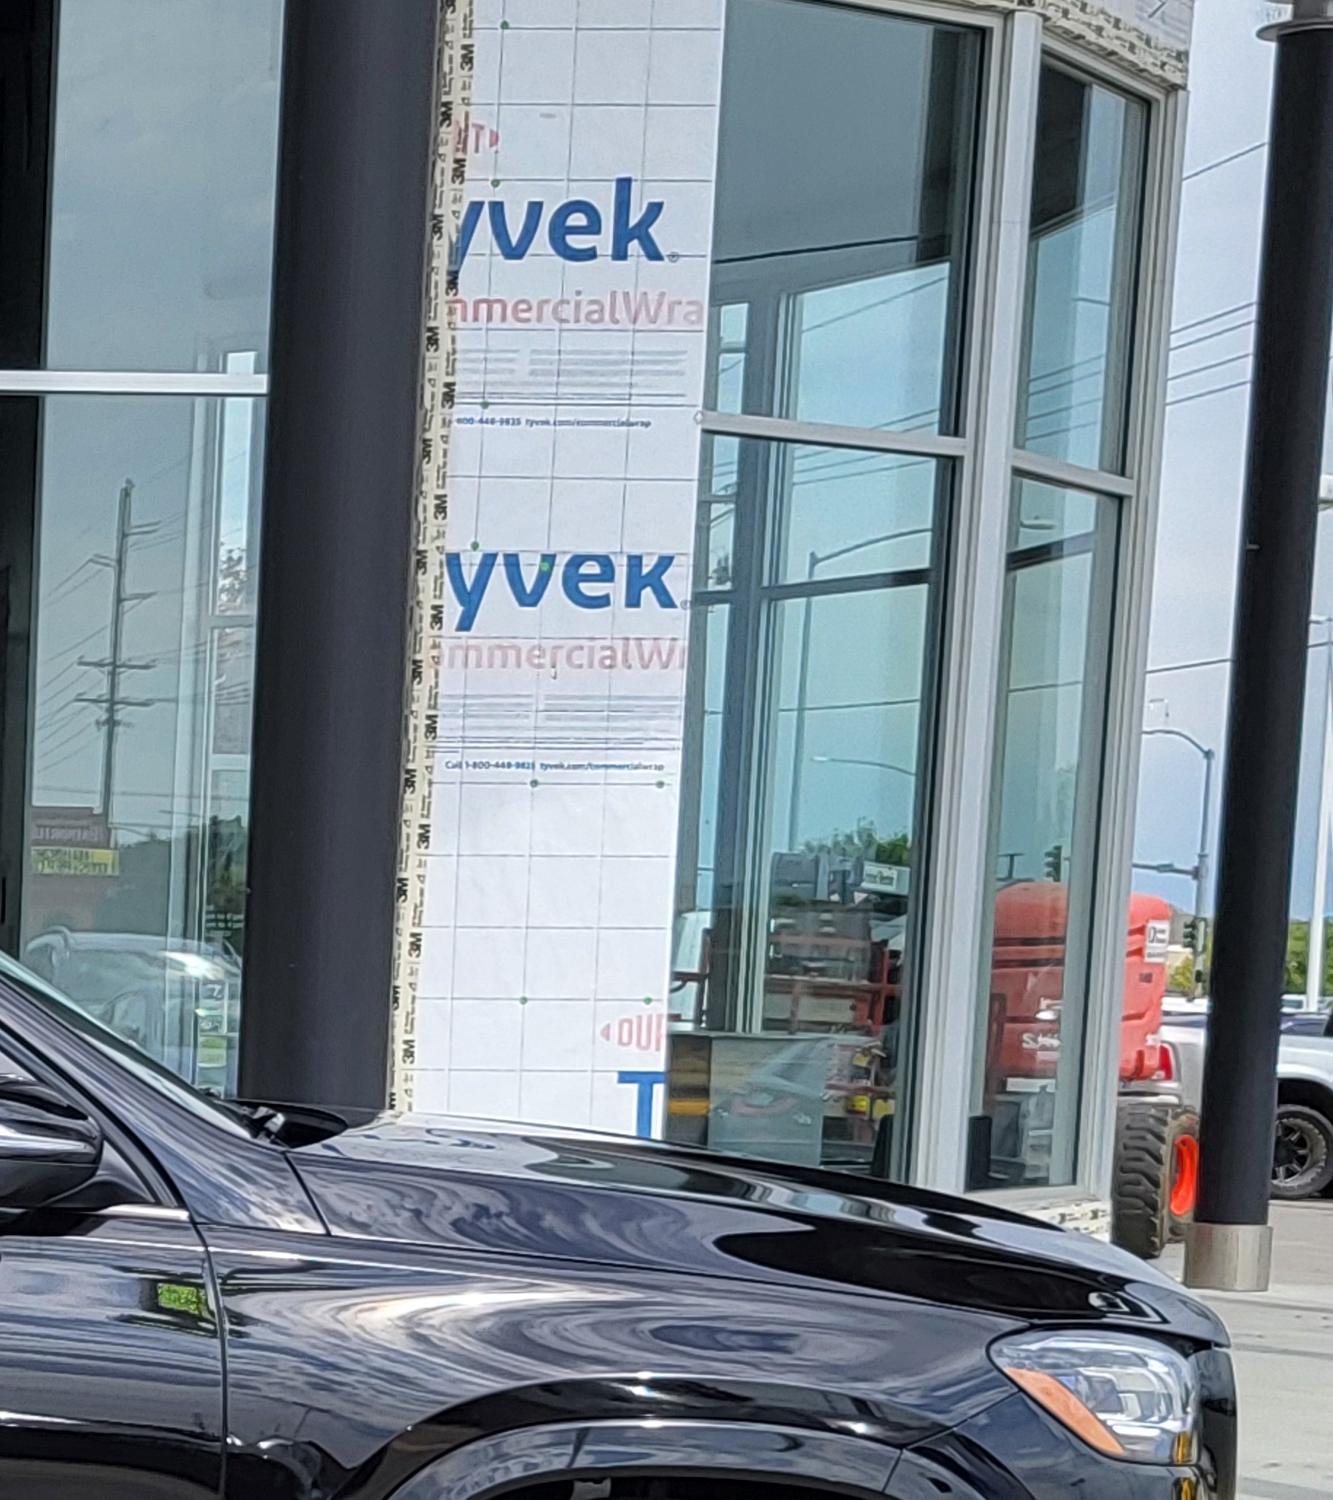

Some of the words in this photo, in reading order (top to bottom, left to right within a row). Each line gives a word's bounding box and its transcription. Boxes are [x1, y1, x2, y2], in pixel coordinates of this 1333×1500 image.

[460, 44, 474, 72] 3M
[452, 158, 466, 185] 3M
[441, 382, 456, 409] 3M
[434, 494, 448, 521] 3M
[445, 552, 678, 632] yvek
[430, 604, 444, 631] 3M
[425, 714, 438, 742] 3M
[417, 824, 431, 850] 3M
[408, 932, 423, 958] 3M
[402, 1039, 415, 1065] 3M
